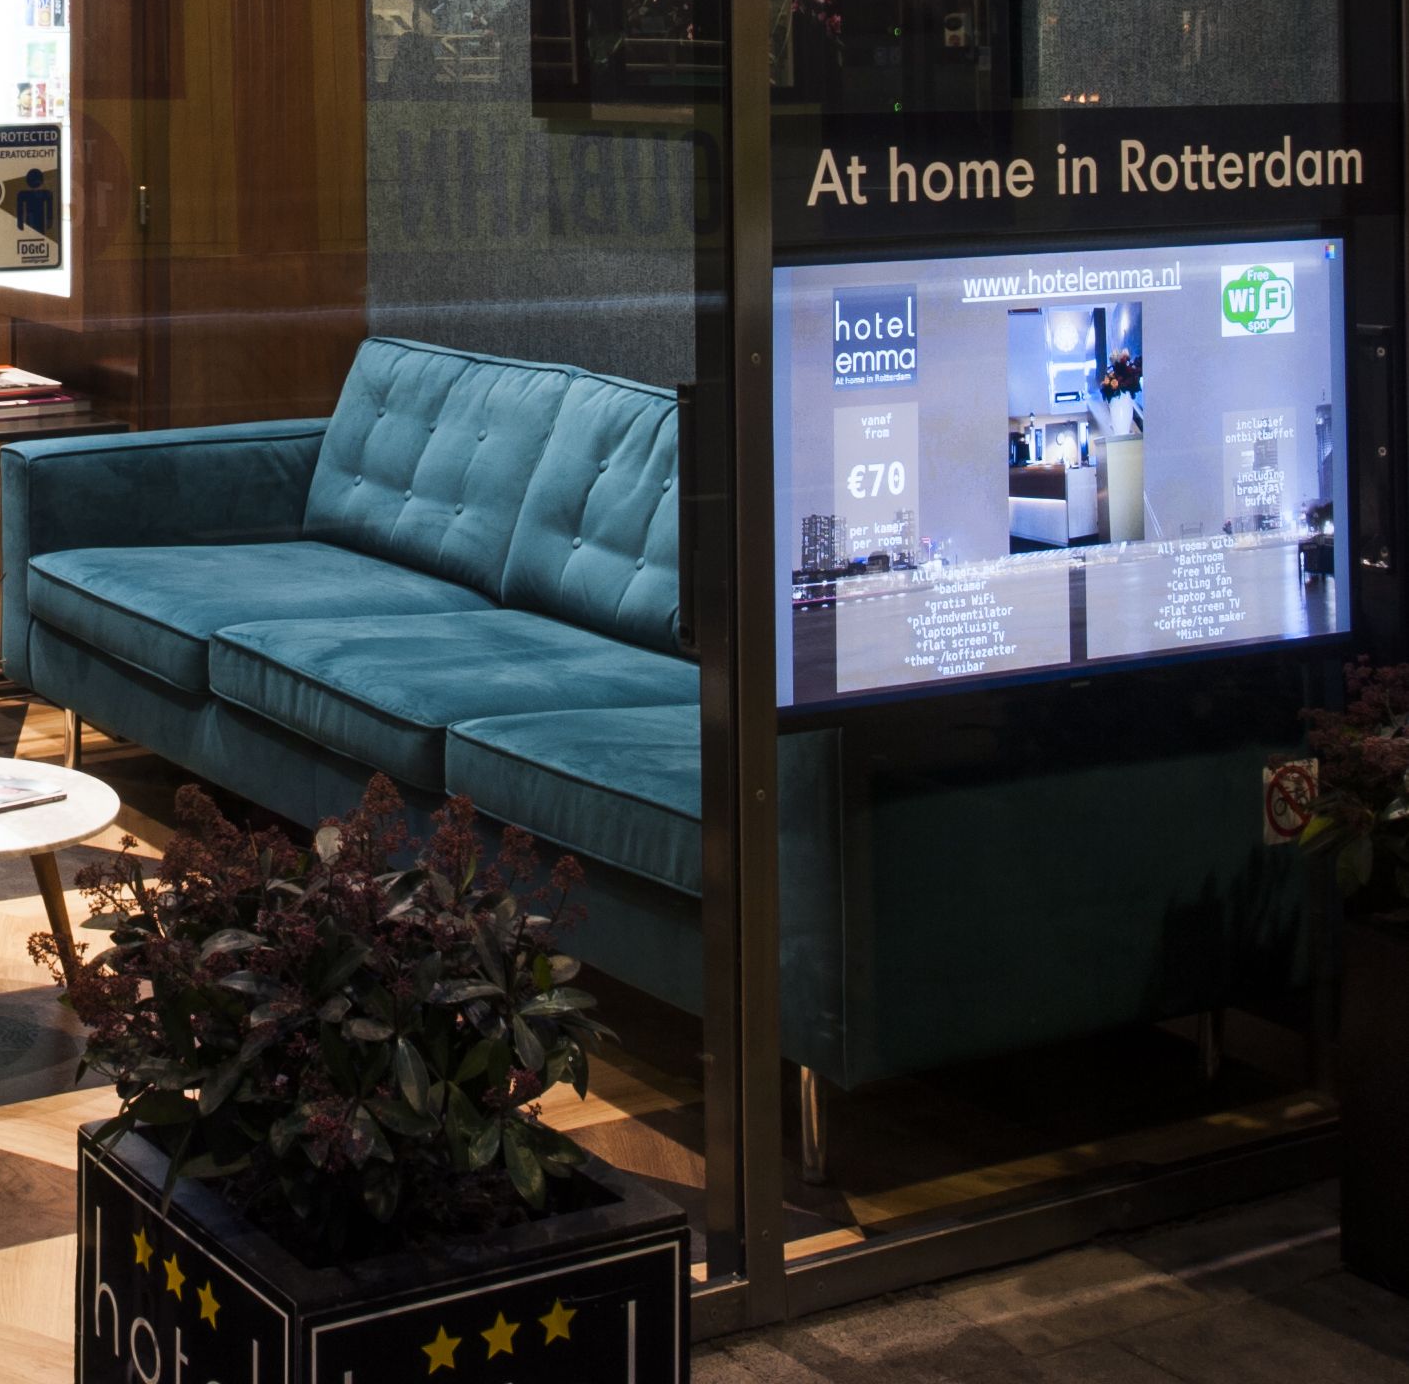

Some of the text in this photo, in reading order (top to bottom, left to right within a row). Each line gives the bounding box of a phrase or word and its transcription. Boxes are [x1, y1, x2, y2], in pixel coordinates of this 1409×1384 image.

[807, 135, 1364, 206] At home in Rotterdam
[963, 261, 1181, 298] www.hotelemma.nl
[1247, 269, 1270, 282] Free
[835, 296, 915, 341] hotel
[835, 348, 915, 374] emma
[861, 412, 892, 426] vanaf
[1236, 416, 1284, 431] inclusief
[864, 427, 890, 440] from
[1224, 427, 1295, 444] ontbijtbuffet
[847, 461, 905, 499] €70
[1237, 470, 1285, 484] including
[1236, 481, 1284, 497] breakfast
[1244, 495, 1277, 507] buffet
[849, 521, 905, 540] per kamer
[853, 536, 903, 552] per room
[1158, 542, 1175, 555] All
[1180, 541, 1207, 553] rooms
[1204, 563, 1226, 575] WiFi
[1216, 574, 1233, 586] fan
[971, 592, 996, 606] WiFi
[1210, 587, 1233, 599] safe
[1192, 601, 1225, 614] screen
[1229, 597, 1241, 609] TV
[1218, 611, 1247, 623] maker
[1208, 625, 1226, 636] bar
[952, 635, 988, 648] screen
[992, 630, 1005, 643] TV
[94, 1205, 259, 1384] hot
